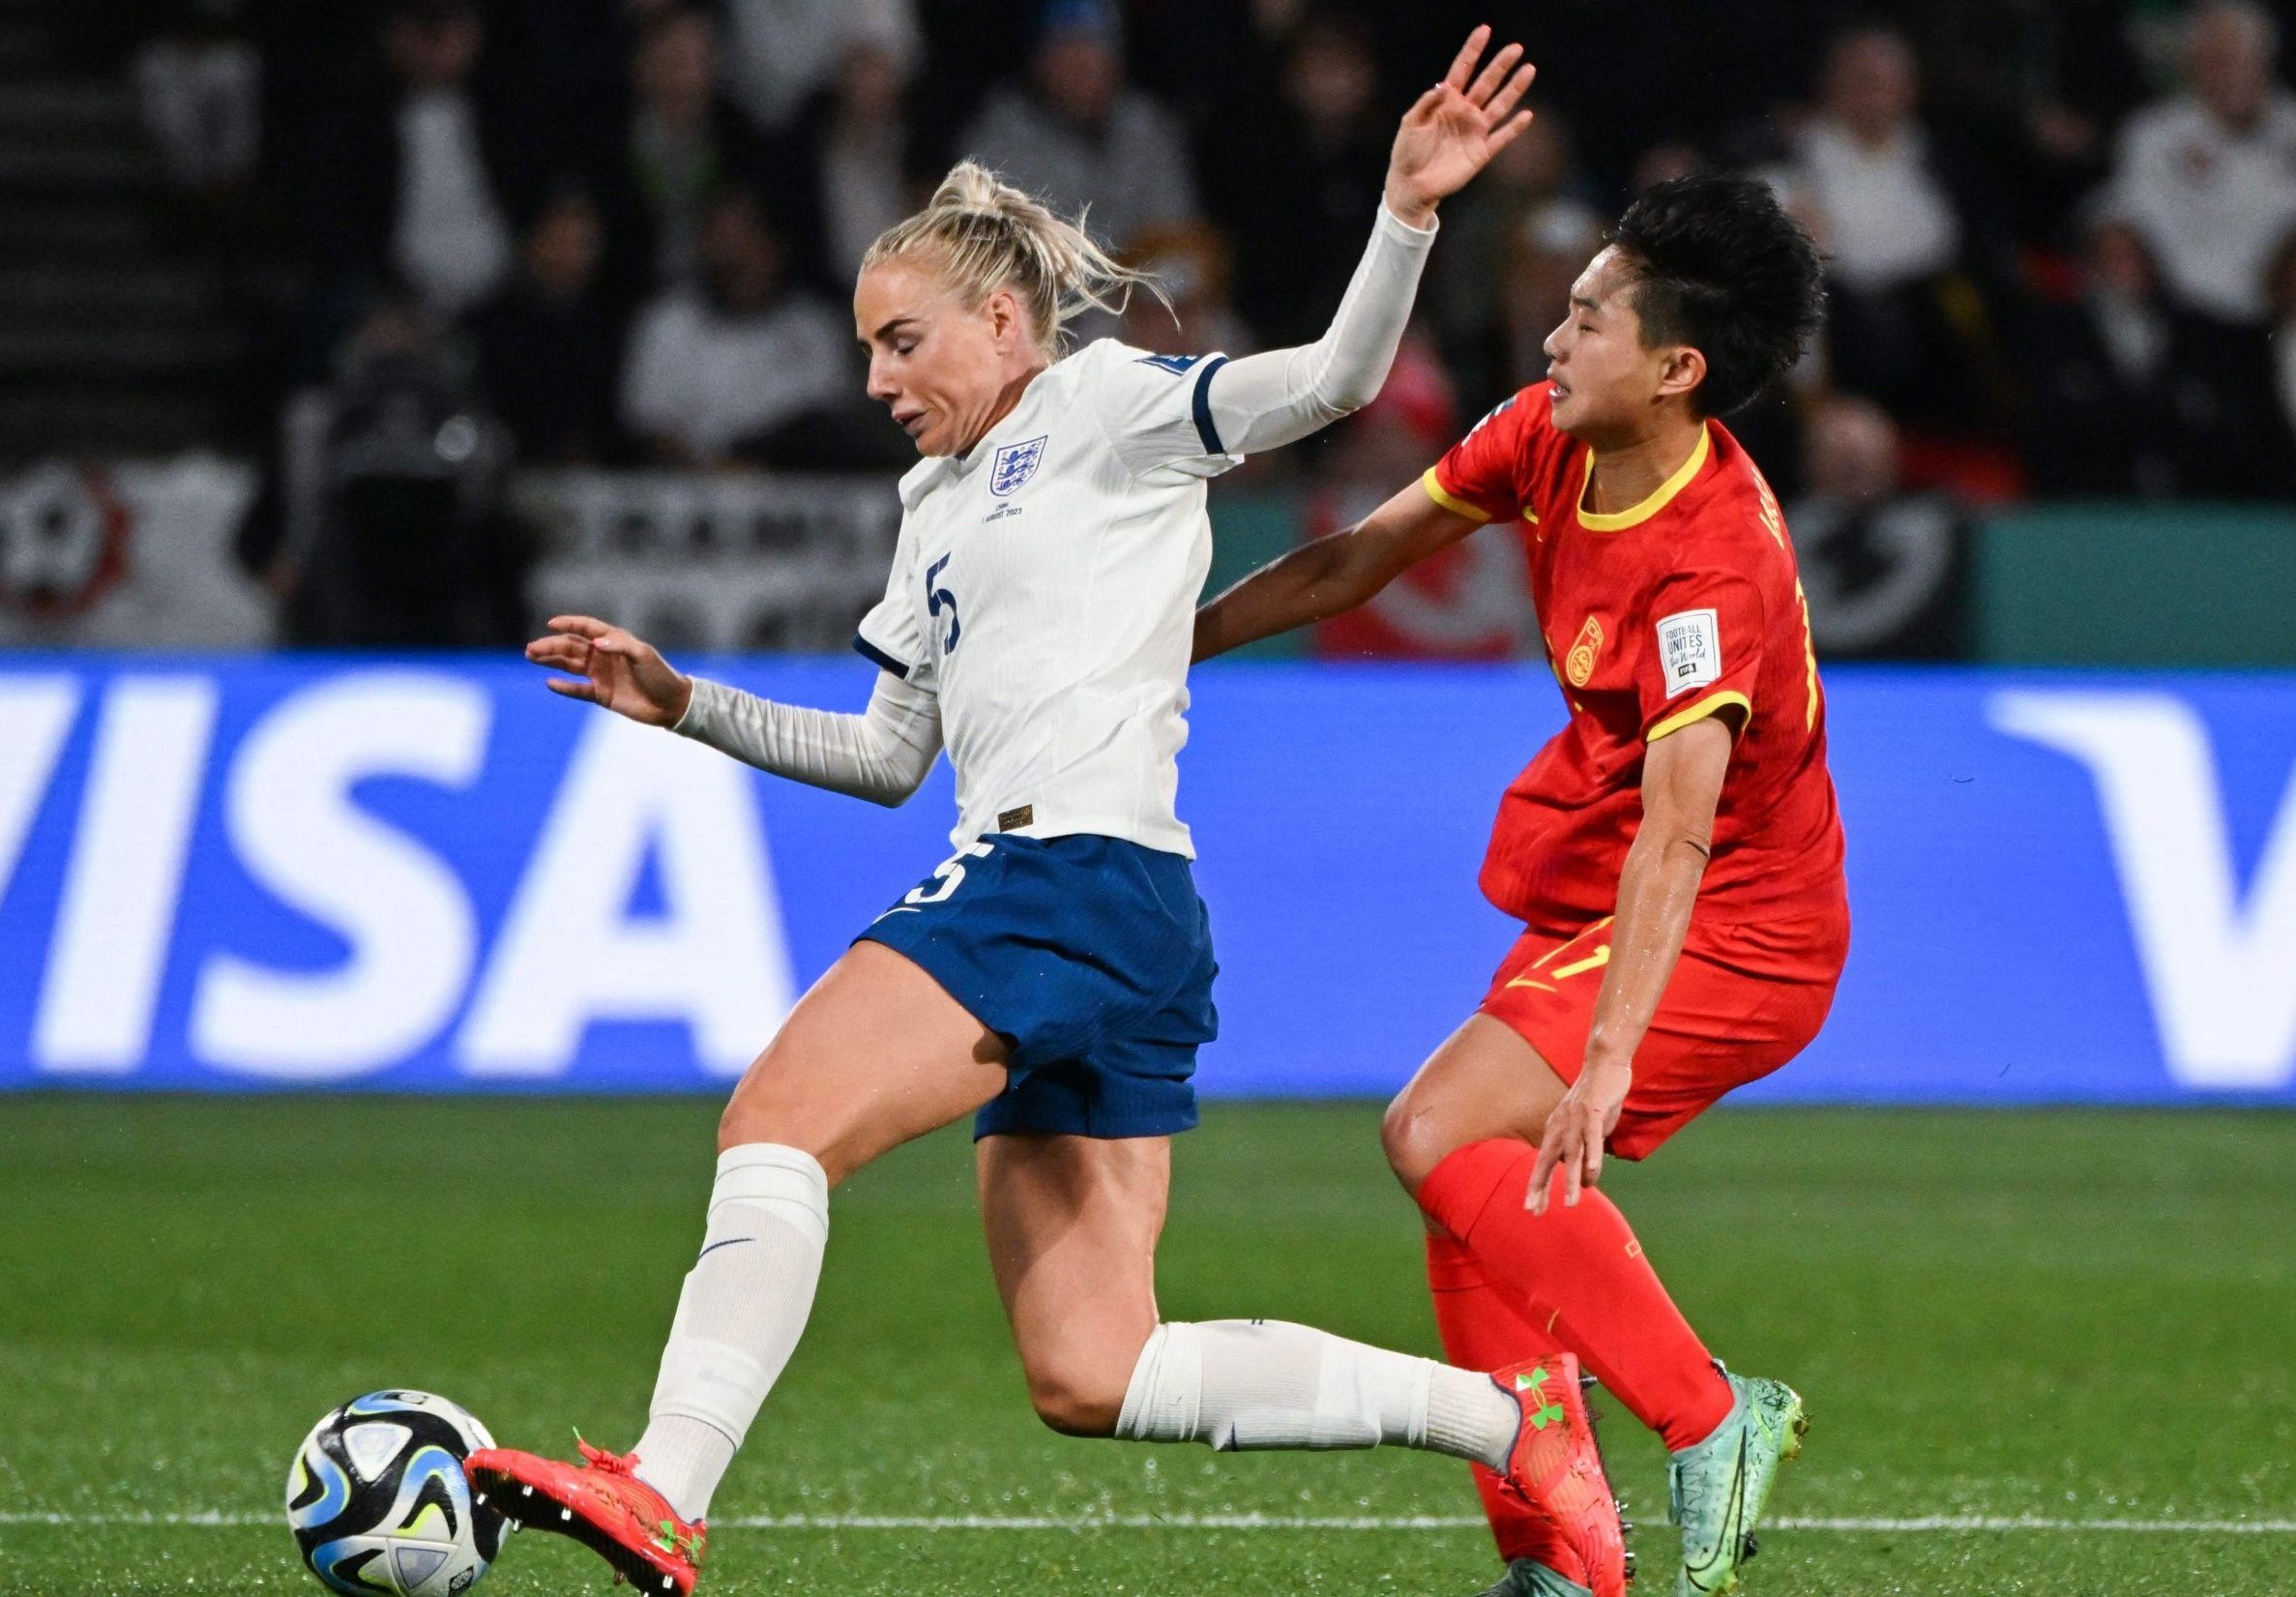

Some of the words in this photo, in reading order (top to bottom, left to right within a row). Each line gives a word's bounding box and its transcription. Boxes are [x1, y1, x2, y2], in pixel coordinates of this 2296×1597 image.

[926, 550, 961, 656] 5
[1665, 624, 1702, 639] FOOTBALL
[1667, 635, 1702, 655] UNITES
[904, 842, 995, 904] 5
